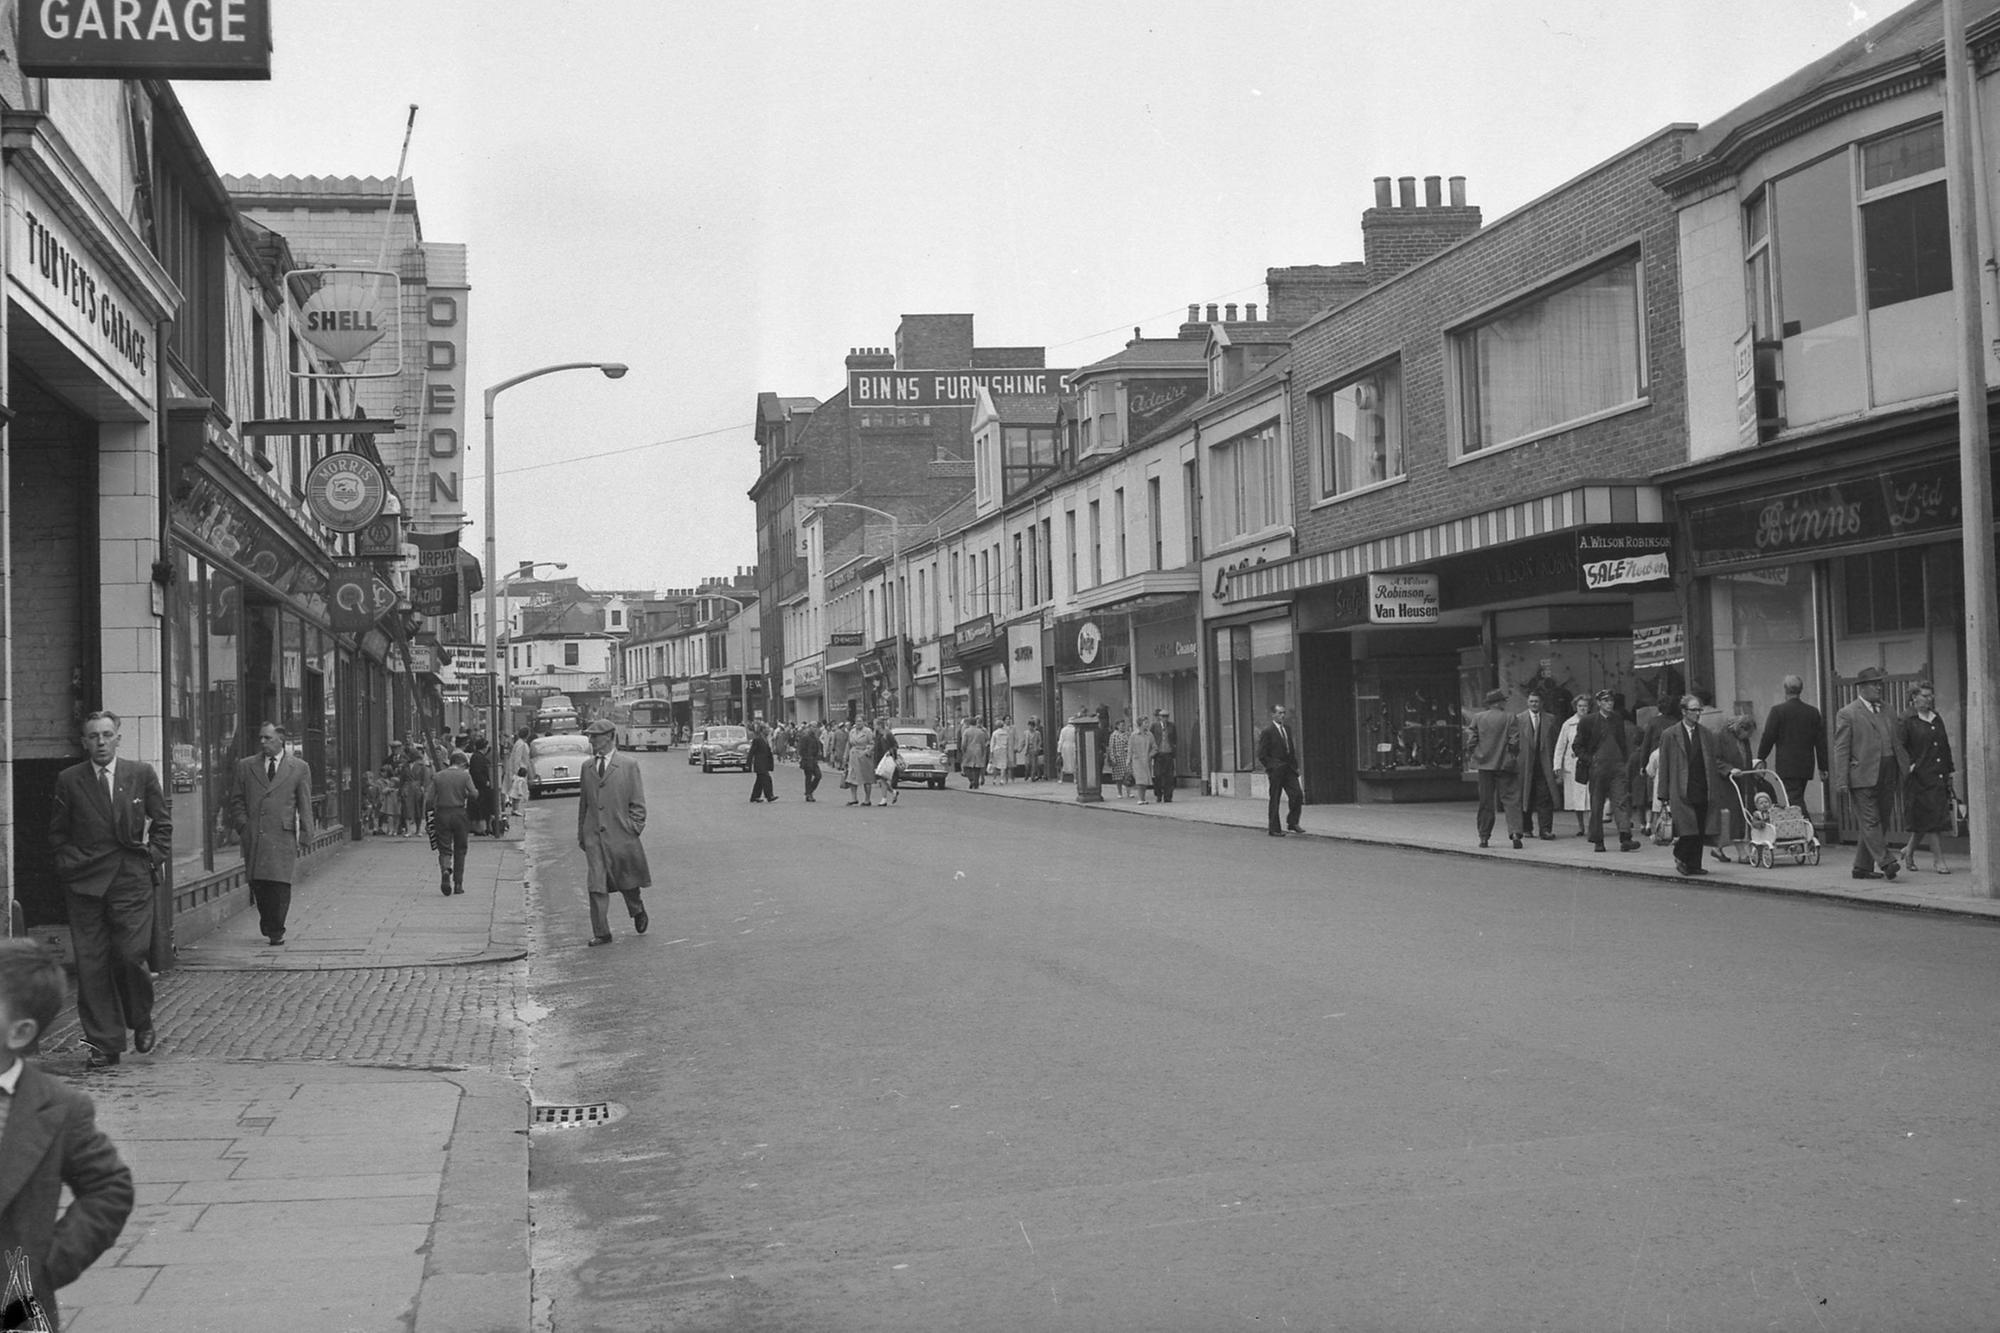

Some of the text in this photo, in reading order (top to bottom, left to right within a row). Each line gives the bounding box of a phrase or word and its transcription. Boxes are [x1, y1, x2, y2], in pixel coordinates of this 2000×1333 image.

[39, 0, 246, 42] GARAGE
[26, 211, 147, 377] TURVEY'S GARAGE
[307, 309, 379, 332] SHELL
[426, 296, 459, 502] ODEON
[859, 376, 919, 401] BINNS
[319, 458, 373, 481] MORRIS
[1755, 498, 1863, 548] Binns
[1590, 536, 1625, 548] WILSON
[1626, 535, 1672, 548] ROBINSON
[419, 550, 456, 567] URPHY
[1587, 560, 1626, 586] SALE
[411, 587, 443, 604] RADIO
[1375, 585, 1424, 599] Robinson
[1375, 602, 1439, 618] Van Heusen
